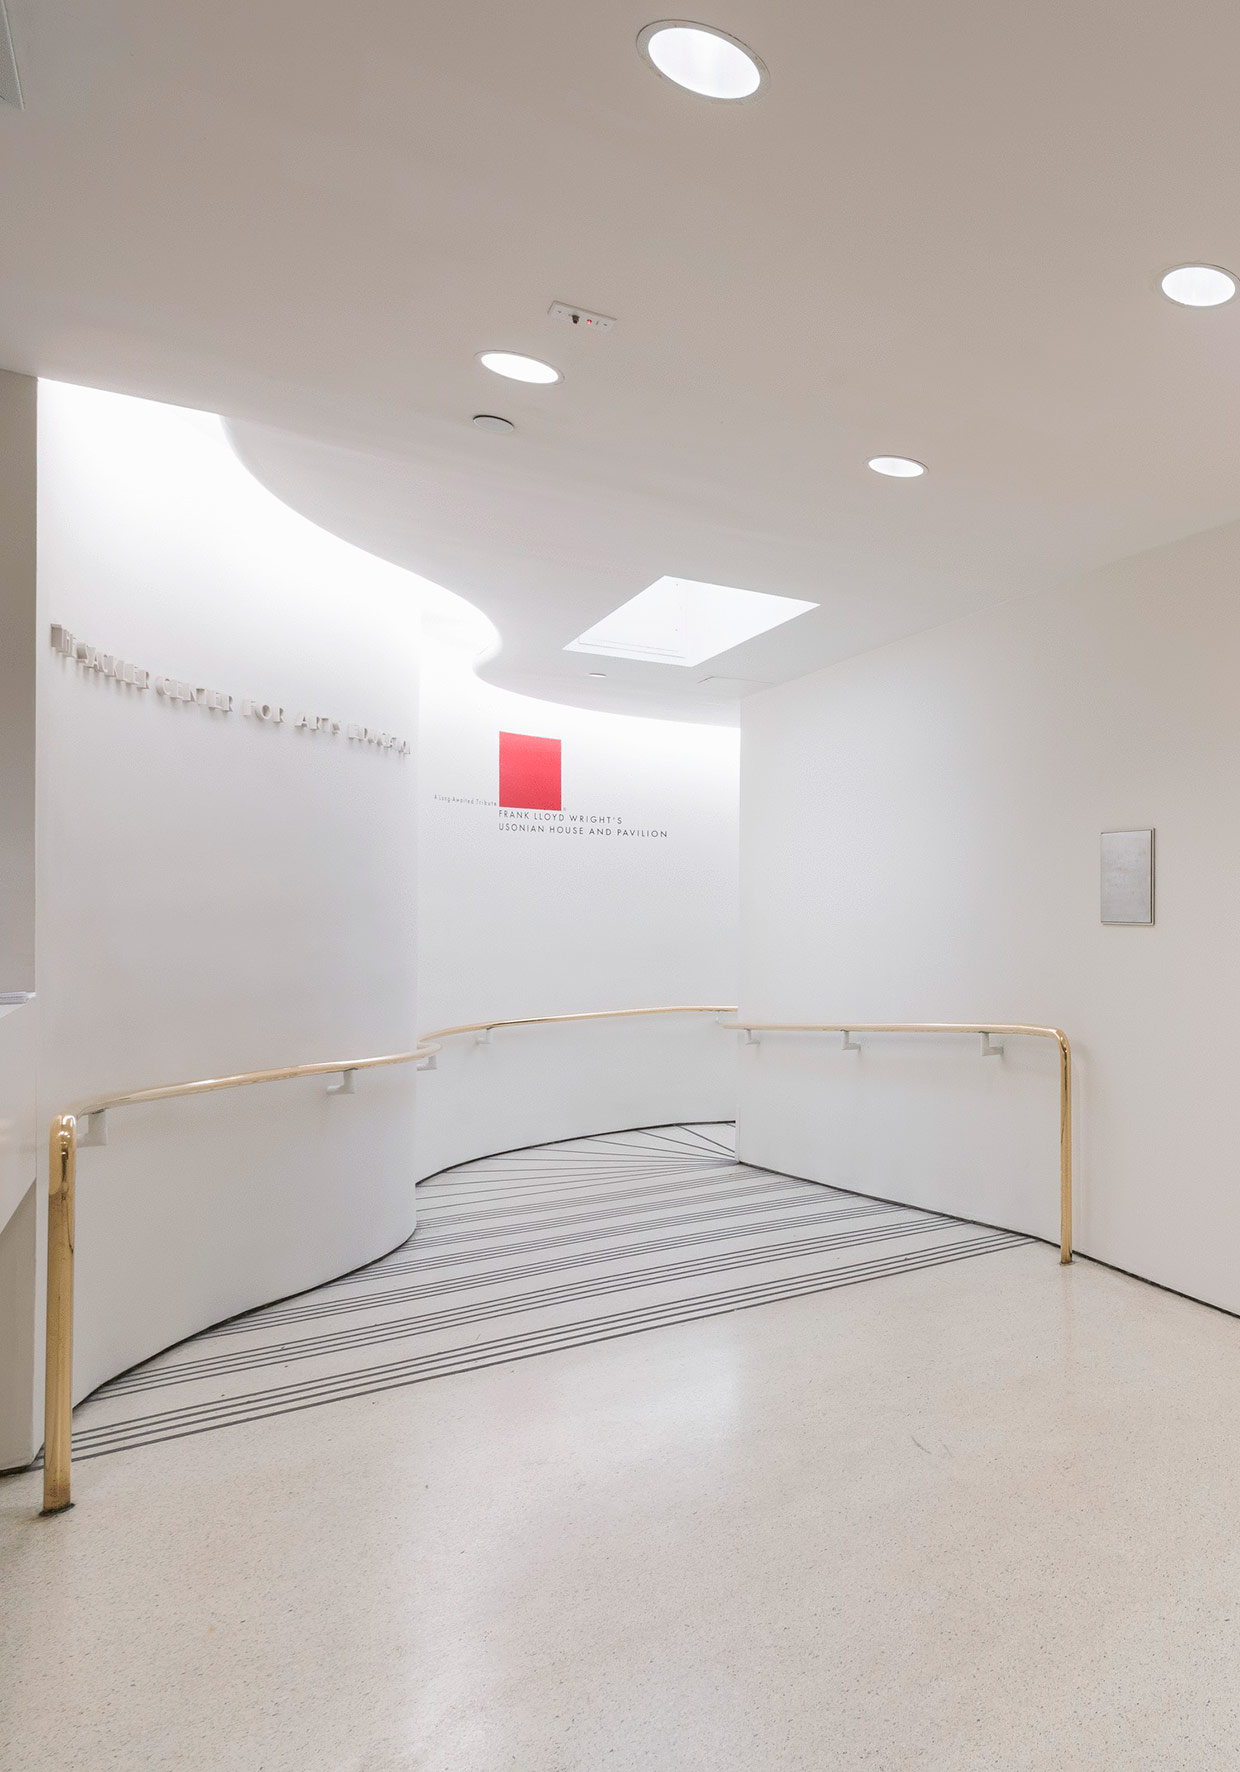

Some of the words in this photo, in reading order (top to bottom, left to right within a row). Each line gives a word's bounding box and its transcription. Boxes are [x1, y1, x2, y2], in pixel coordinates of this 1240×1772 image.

[155, 674, 233, 712] CENTER
[243, 698, 284, 723] FOR
[499, 810, 530, 820] FRANK
[533, 812, 565, 822] LLOYD
[569, 815, 623, 825] WRIGHT'S
[498, 823, 545, 833] USONIAN
[549, 826, 584, 835] HOUSE
[589, 828, 612, 837] AND
[617, 828, 668, 838] PAVILION
